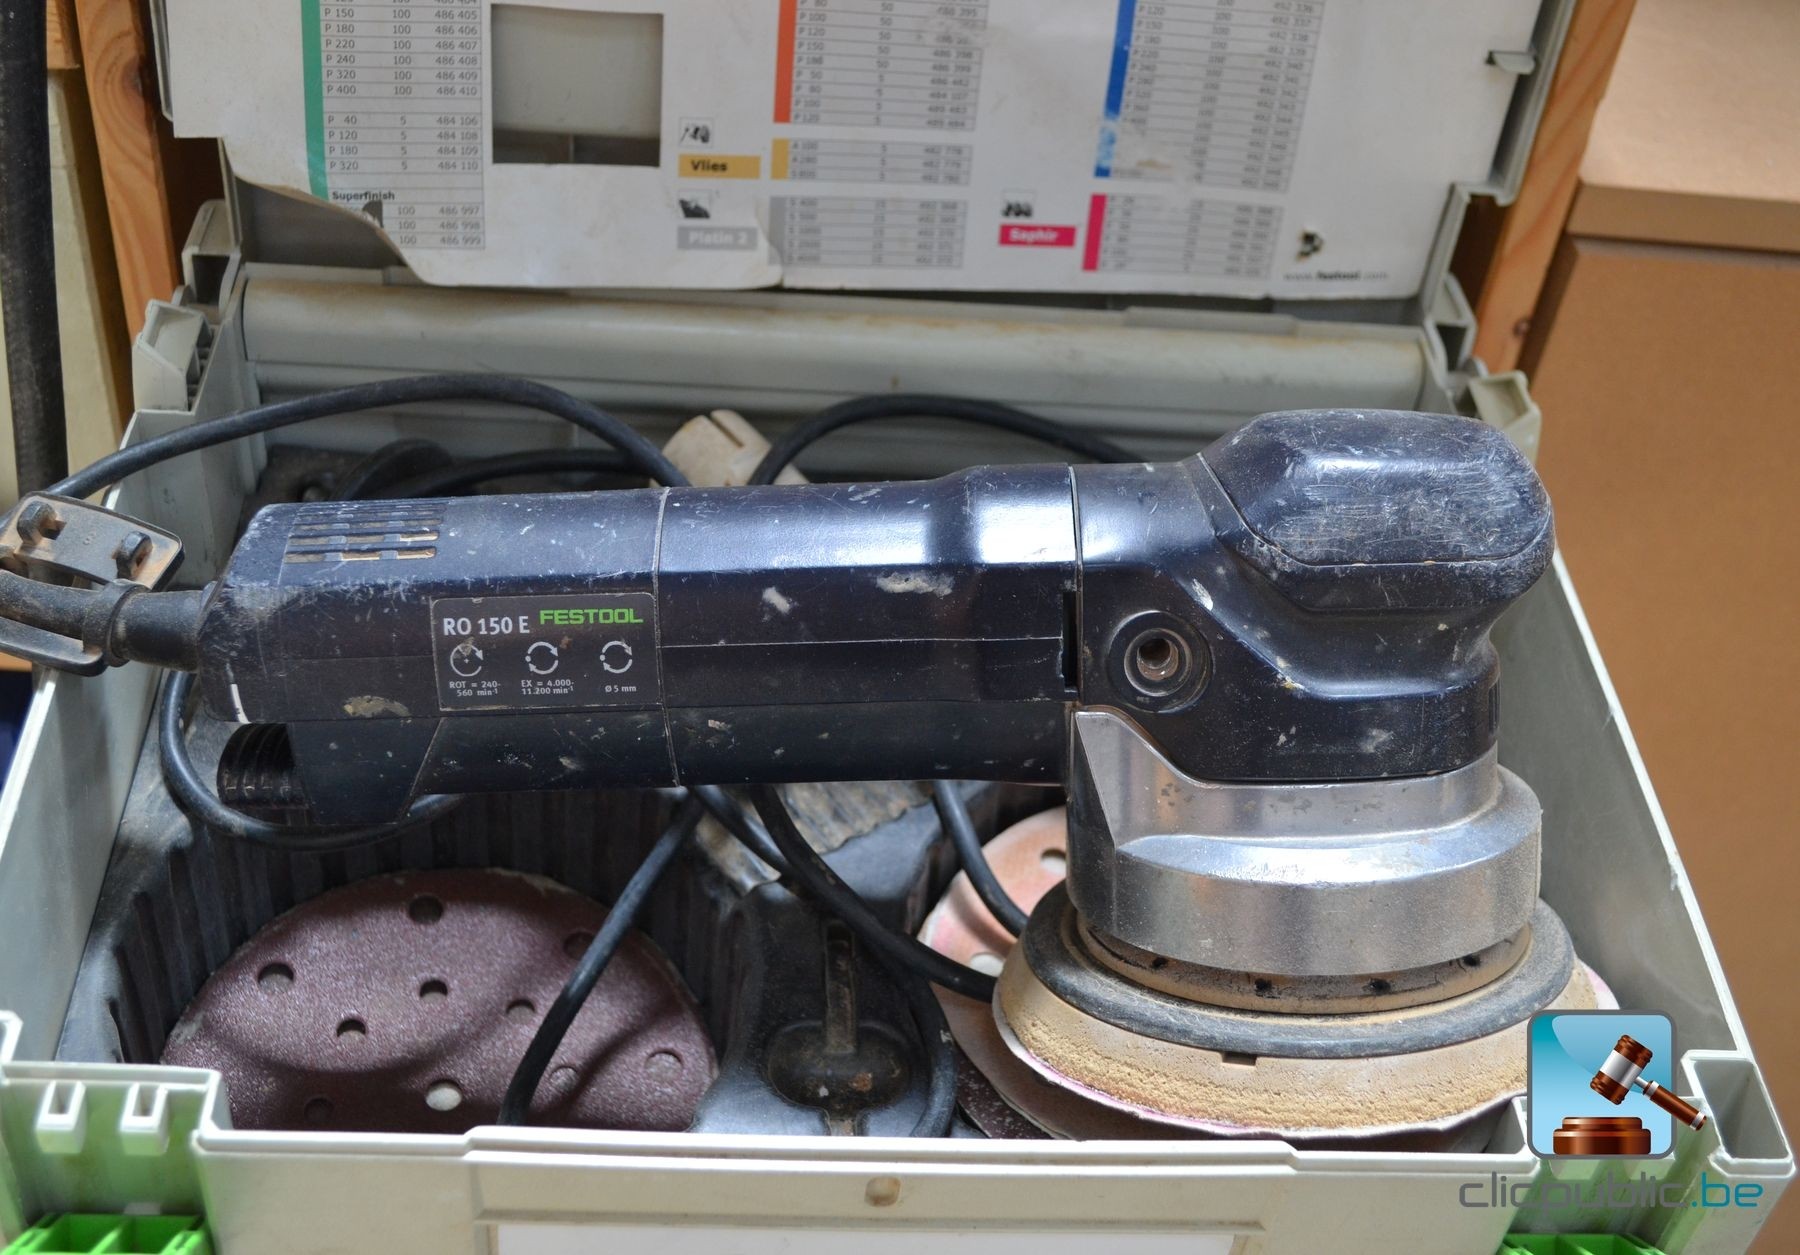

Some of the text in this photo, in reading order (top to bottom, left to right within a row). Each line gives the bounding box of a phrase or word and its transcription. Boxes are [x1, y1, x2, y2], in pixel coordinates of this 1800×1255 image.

[325, 8, 477, 20] P 150 100 486 405
[325, 23, 477, 34] P 180 100 486 406
[326, 39, 477, 50] P 220 100 486 407
[326, 54, 477, 65] P 240 100 486 408
[327, 69, 477, 80] P 320 100 486 409
[327, 85, 477, 96] P 400 100 486 410
[328, 115, 478, 125] P 40 5 484 106
[329, 131, 334, 139] P
[339, 131, 357, 140] 120
[400, 132, 407, 140] 5
[437, 132, 456, 140] 484
[329, 146, 335, 155] P
[340, 146, 358, 155] 180
[401, 147, 407, 155] 5
[437, 147, 456, 155] 484
[330, 161, 478, 170] P 320 5 484 110
[690, 159, 728, 172] Vlies
[332, 191, 395, 202] Superfinish
[398, 207, 415, 215] 100
[398, 221, 416, 230] 100
[399, 236, 416, 245] 100
[689, 231, 733, 244] Platin
[539, 608, 644, 625] FESTOOL
[443, 615, 530, 636] RO 150 E
[449, 681, 466, 689] ROT
[521, 680, 532, 688] EX
[457, 689, 473, 697] 560
[521, 687, 551, 695] 11.200
